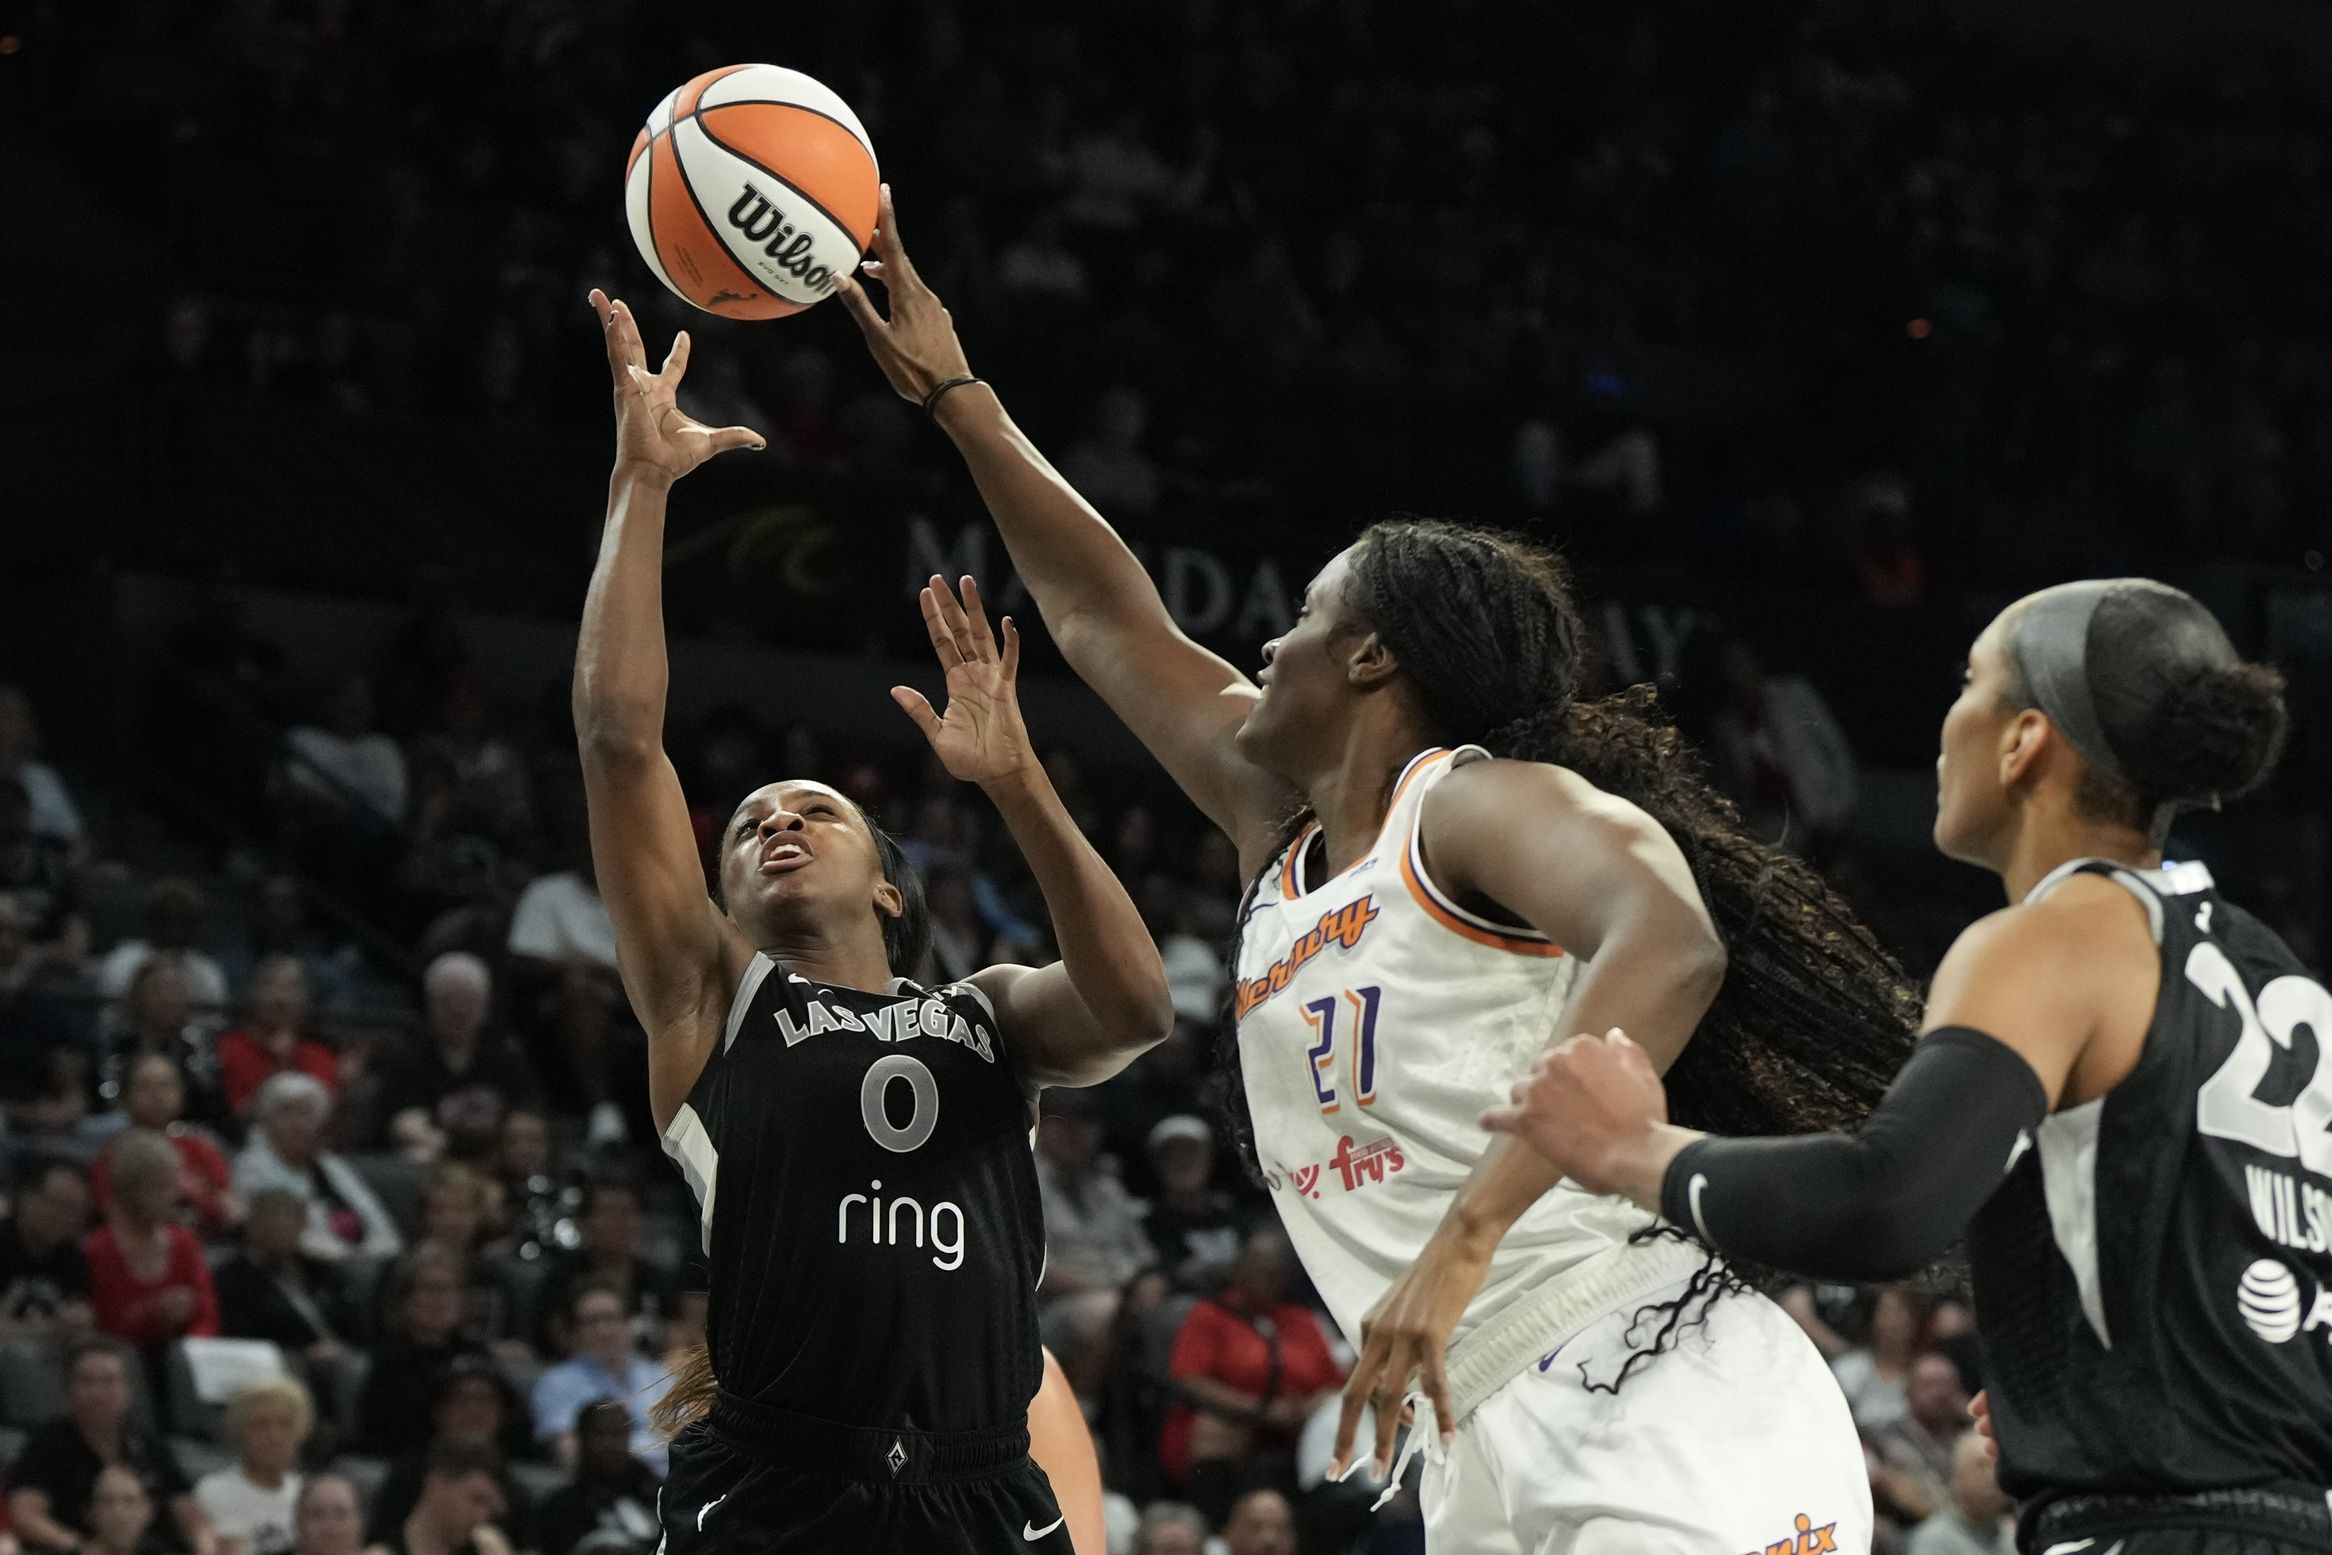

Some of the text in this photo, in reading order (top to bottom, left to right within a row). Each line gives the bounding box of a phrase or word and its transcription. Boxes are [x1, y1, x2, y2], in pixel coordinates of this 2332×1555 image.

[774, 998, 995, 1064] LAS VEGAS
[1299, 986, 1381, 1115] 21
[860, 1054, 939, 1153] 0
[839, 1179, 964, 1271] ring
[2245, 1164, 2332, 1256] WILS
